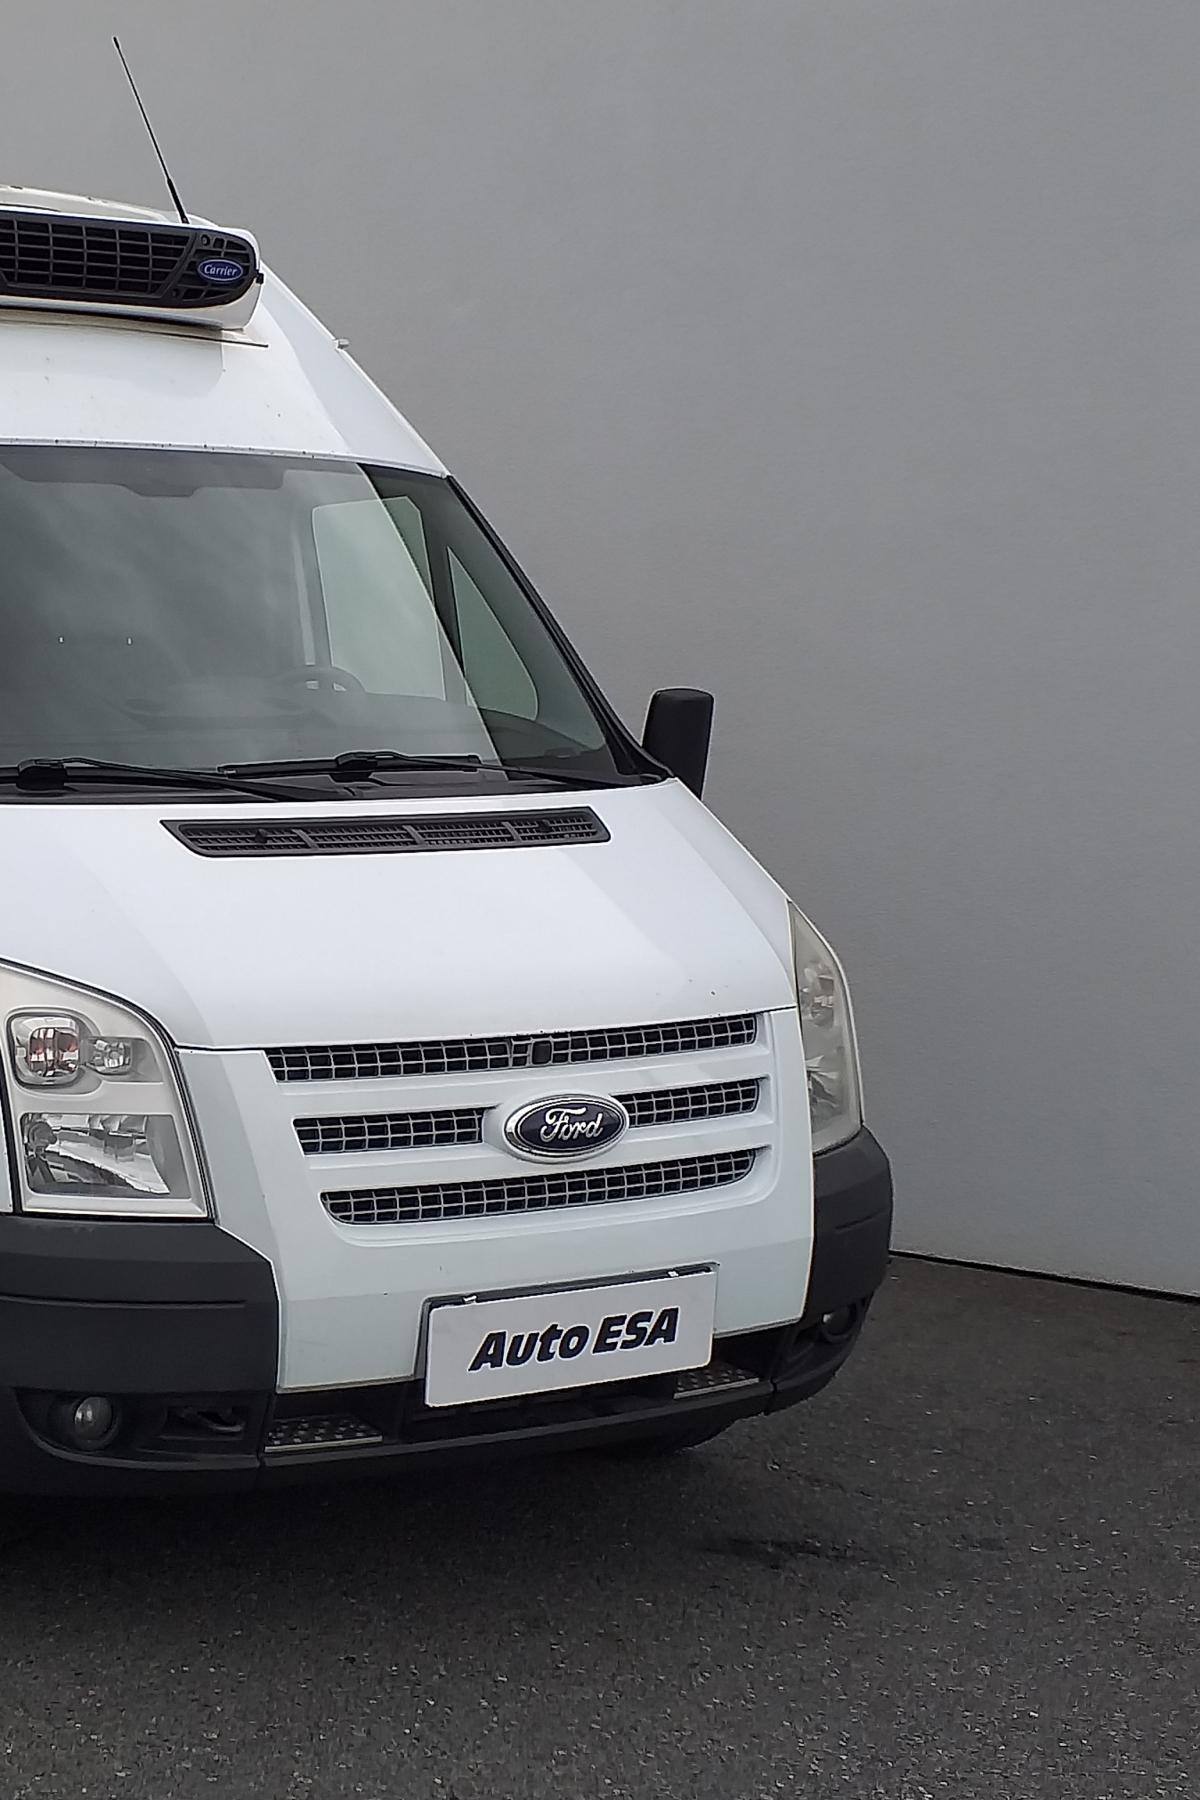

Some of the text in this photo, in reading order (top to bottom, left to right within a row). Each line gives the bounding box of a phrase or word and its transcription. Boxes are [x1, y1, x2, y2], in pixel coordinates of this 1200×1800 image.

[203, 264, 238, 277] Carrier
[540, 1106, 603, 1142] Ford
[468, 1306, 680, 1371] Auto ESA
